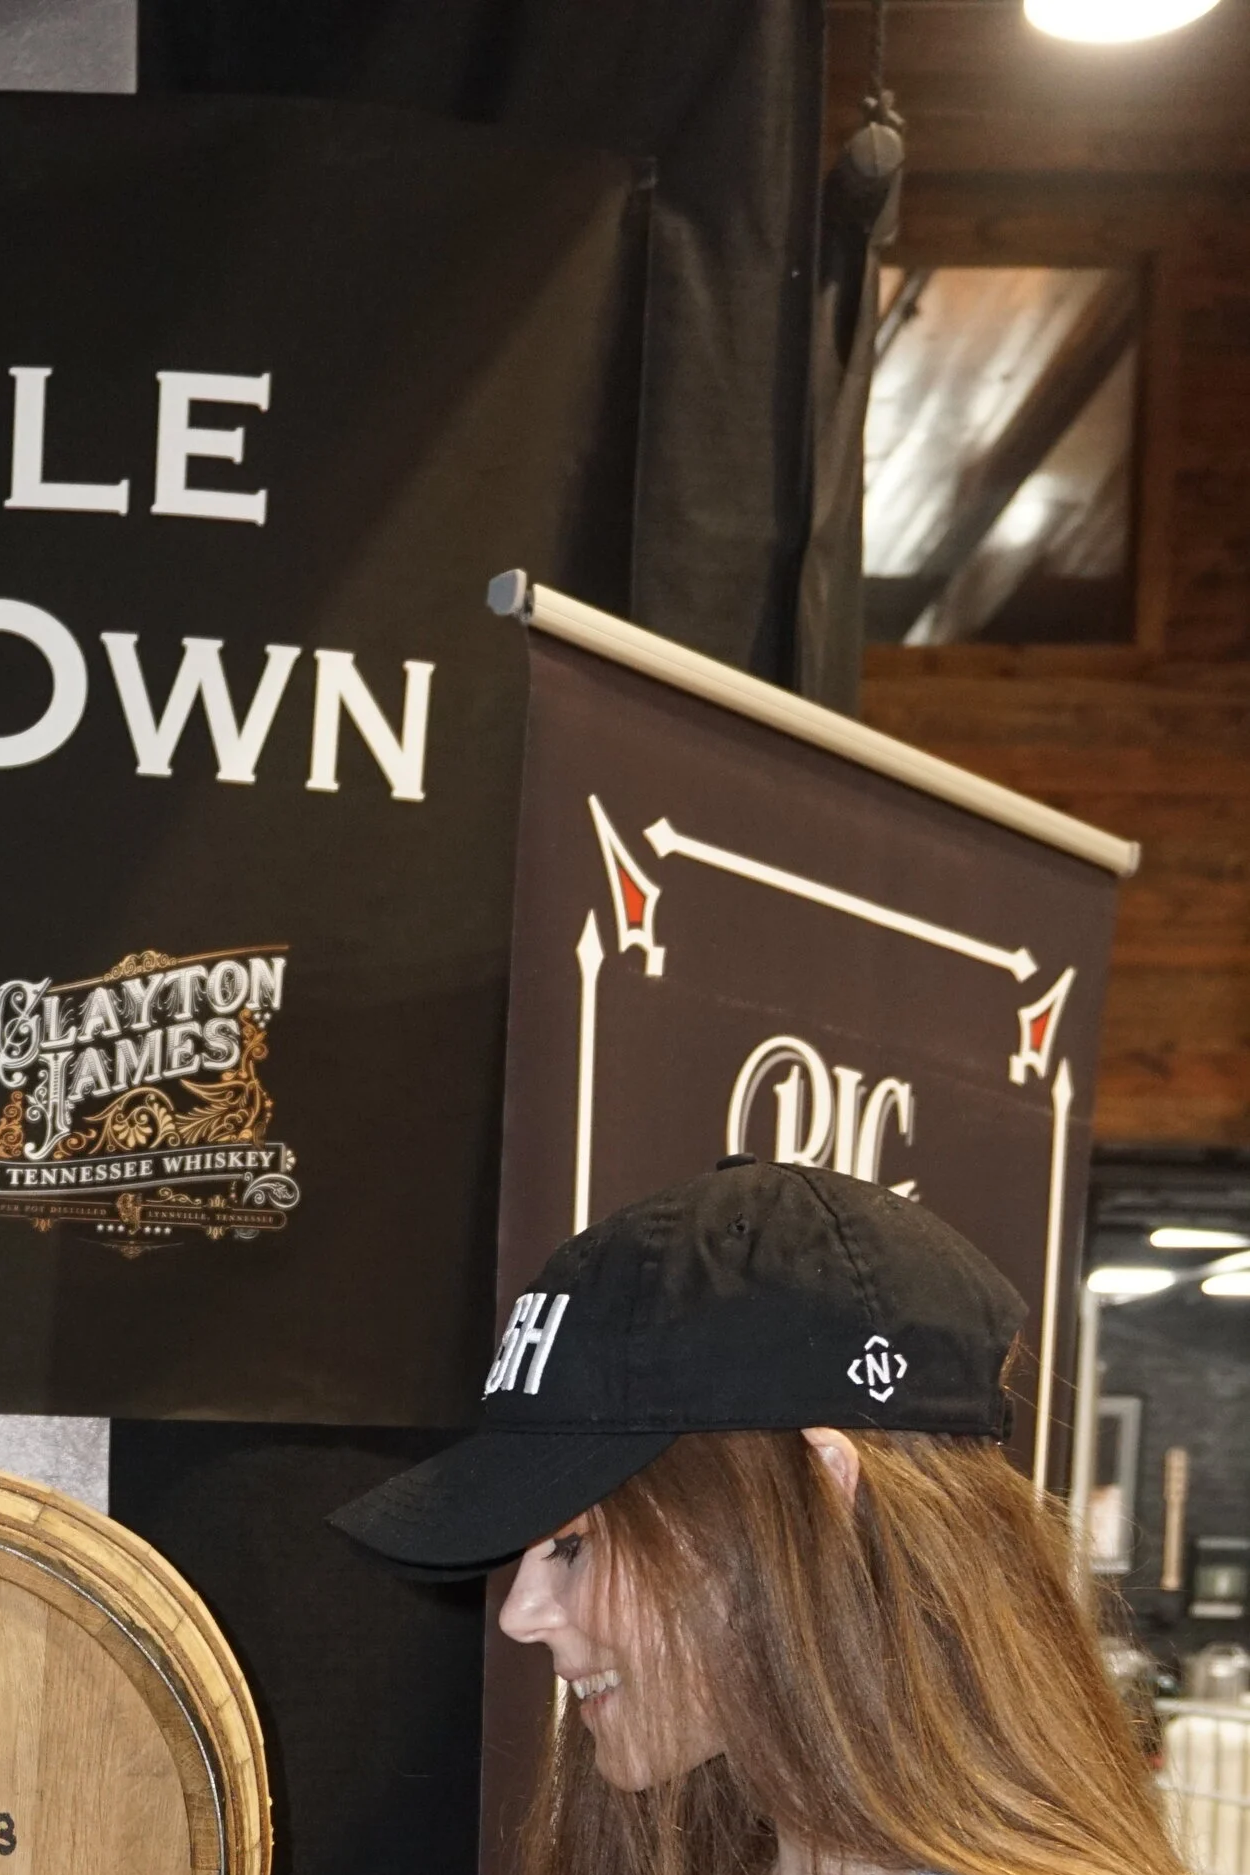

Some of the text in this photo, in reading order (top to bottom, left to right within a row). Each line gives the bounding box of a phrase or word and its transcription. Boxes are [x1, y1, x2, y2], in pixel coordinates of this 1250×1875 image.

[24, 1017, 241, 1160] JAMES
[6, 1151, 276, 1187] TENNESSEE WHISKEY
